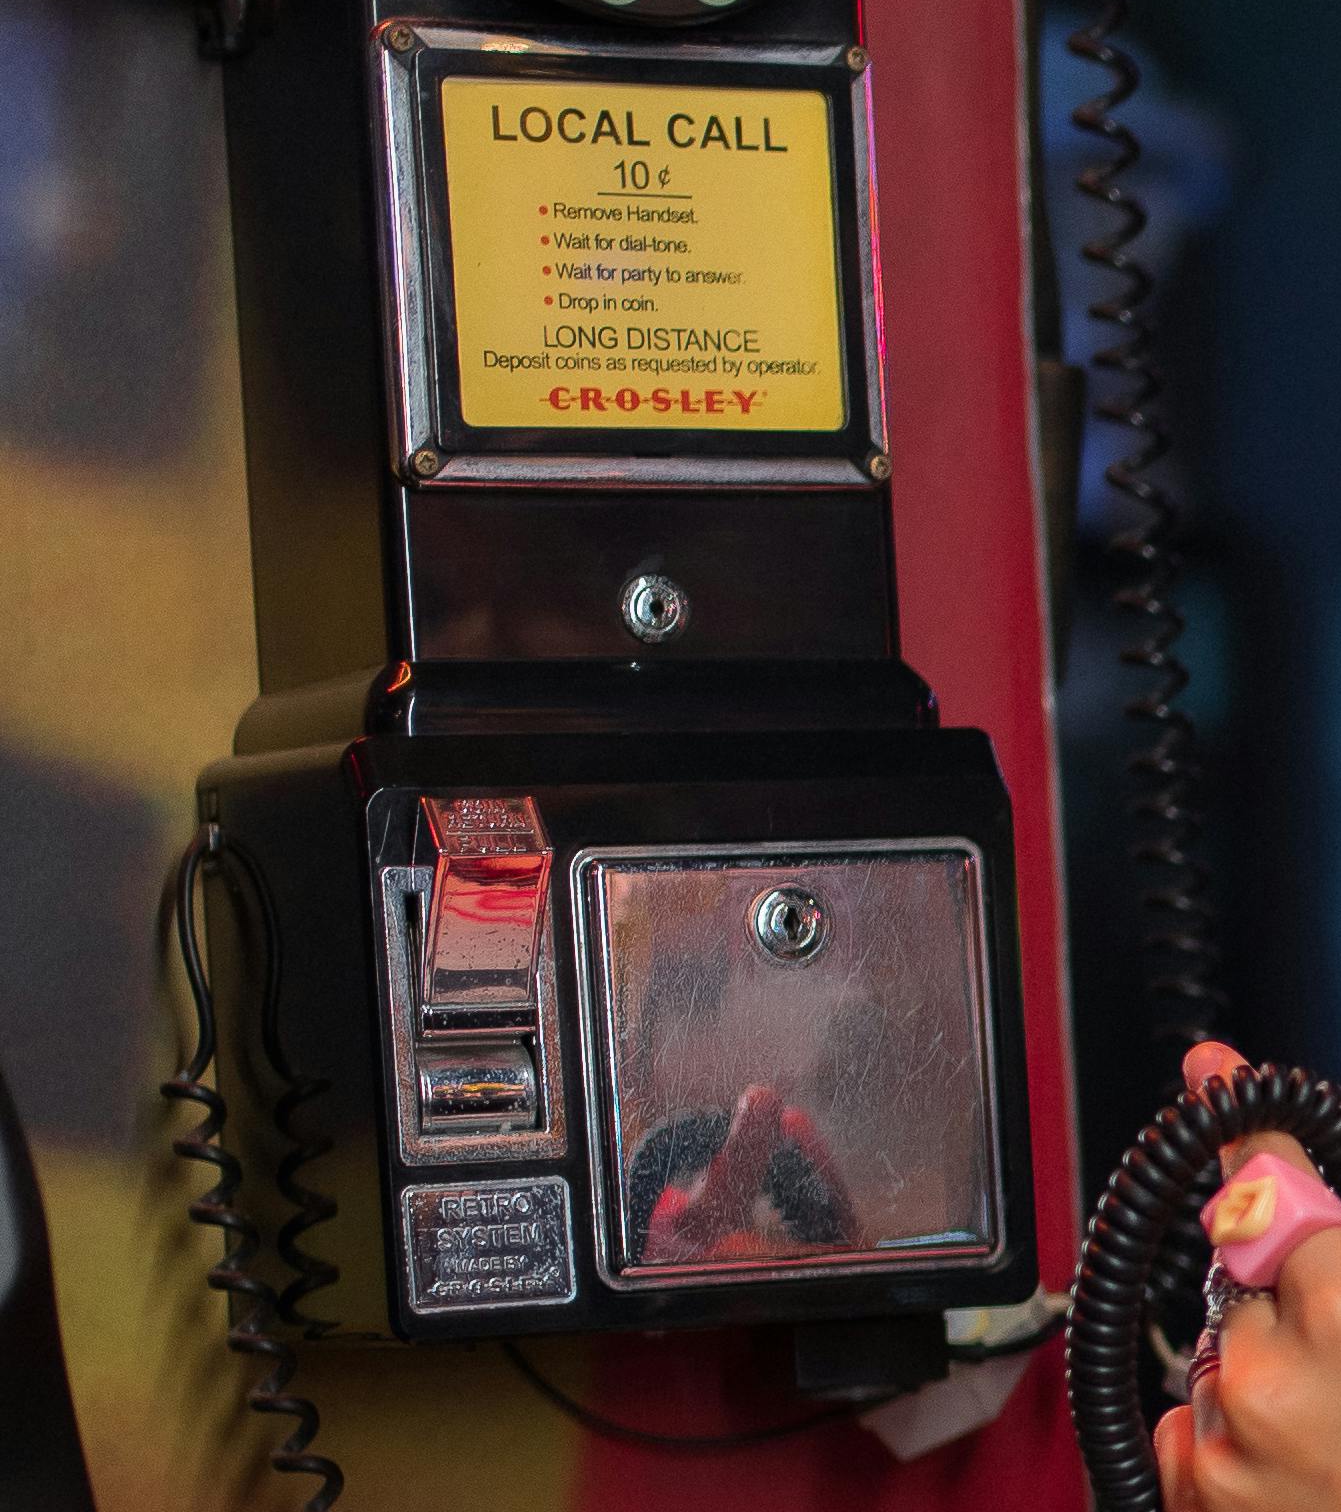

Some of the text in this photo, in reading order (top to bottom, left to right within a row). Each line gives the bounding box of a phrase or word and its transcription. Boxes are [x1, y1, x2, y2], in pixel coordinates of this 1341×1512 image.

[491, 105, 788, 152] LOCAL CALL
[613, 159, 650, 190] 10
[553, 202, 698, 224] Remove Handset.
[554, 232, 692, 254] Wait for dial-tone.
[555, 262, 746, 286] Wait for party to answer.
[558, 292, 659, 314] Drop in coin.
[543, 325, 761, 353] LONG DISTANCE
[483, 350, 822, 377] Deposit coins as requested by operator.
[548, 387, 758, 415] CROSLEY
[442, 1191, 533, 1220] RETRO
[437, 1222, 543, 1251] SYSTEM
[455, 1255, 529, 1273] MADE BY
